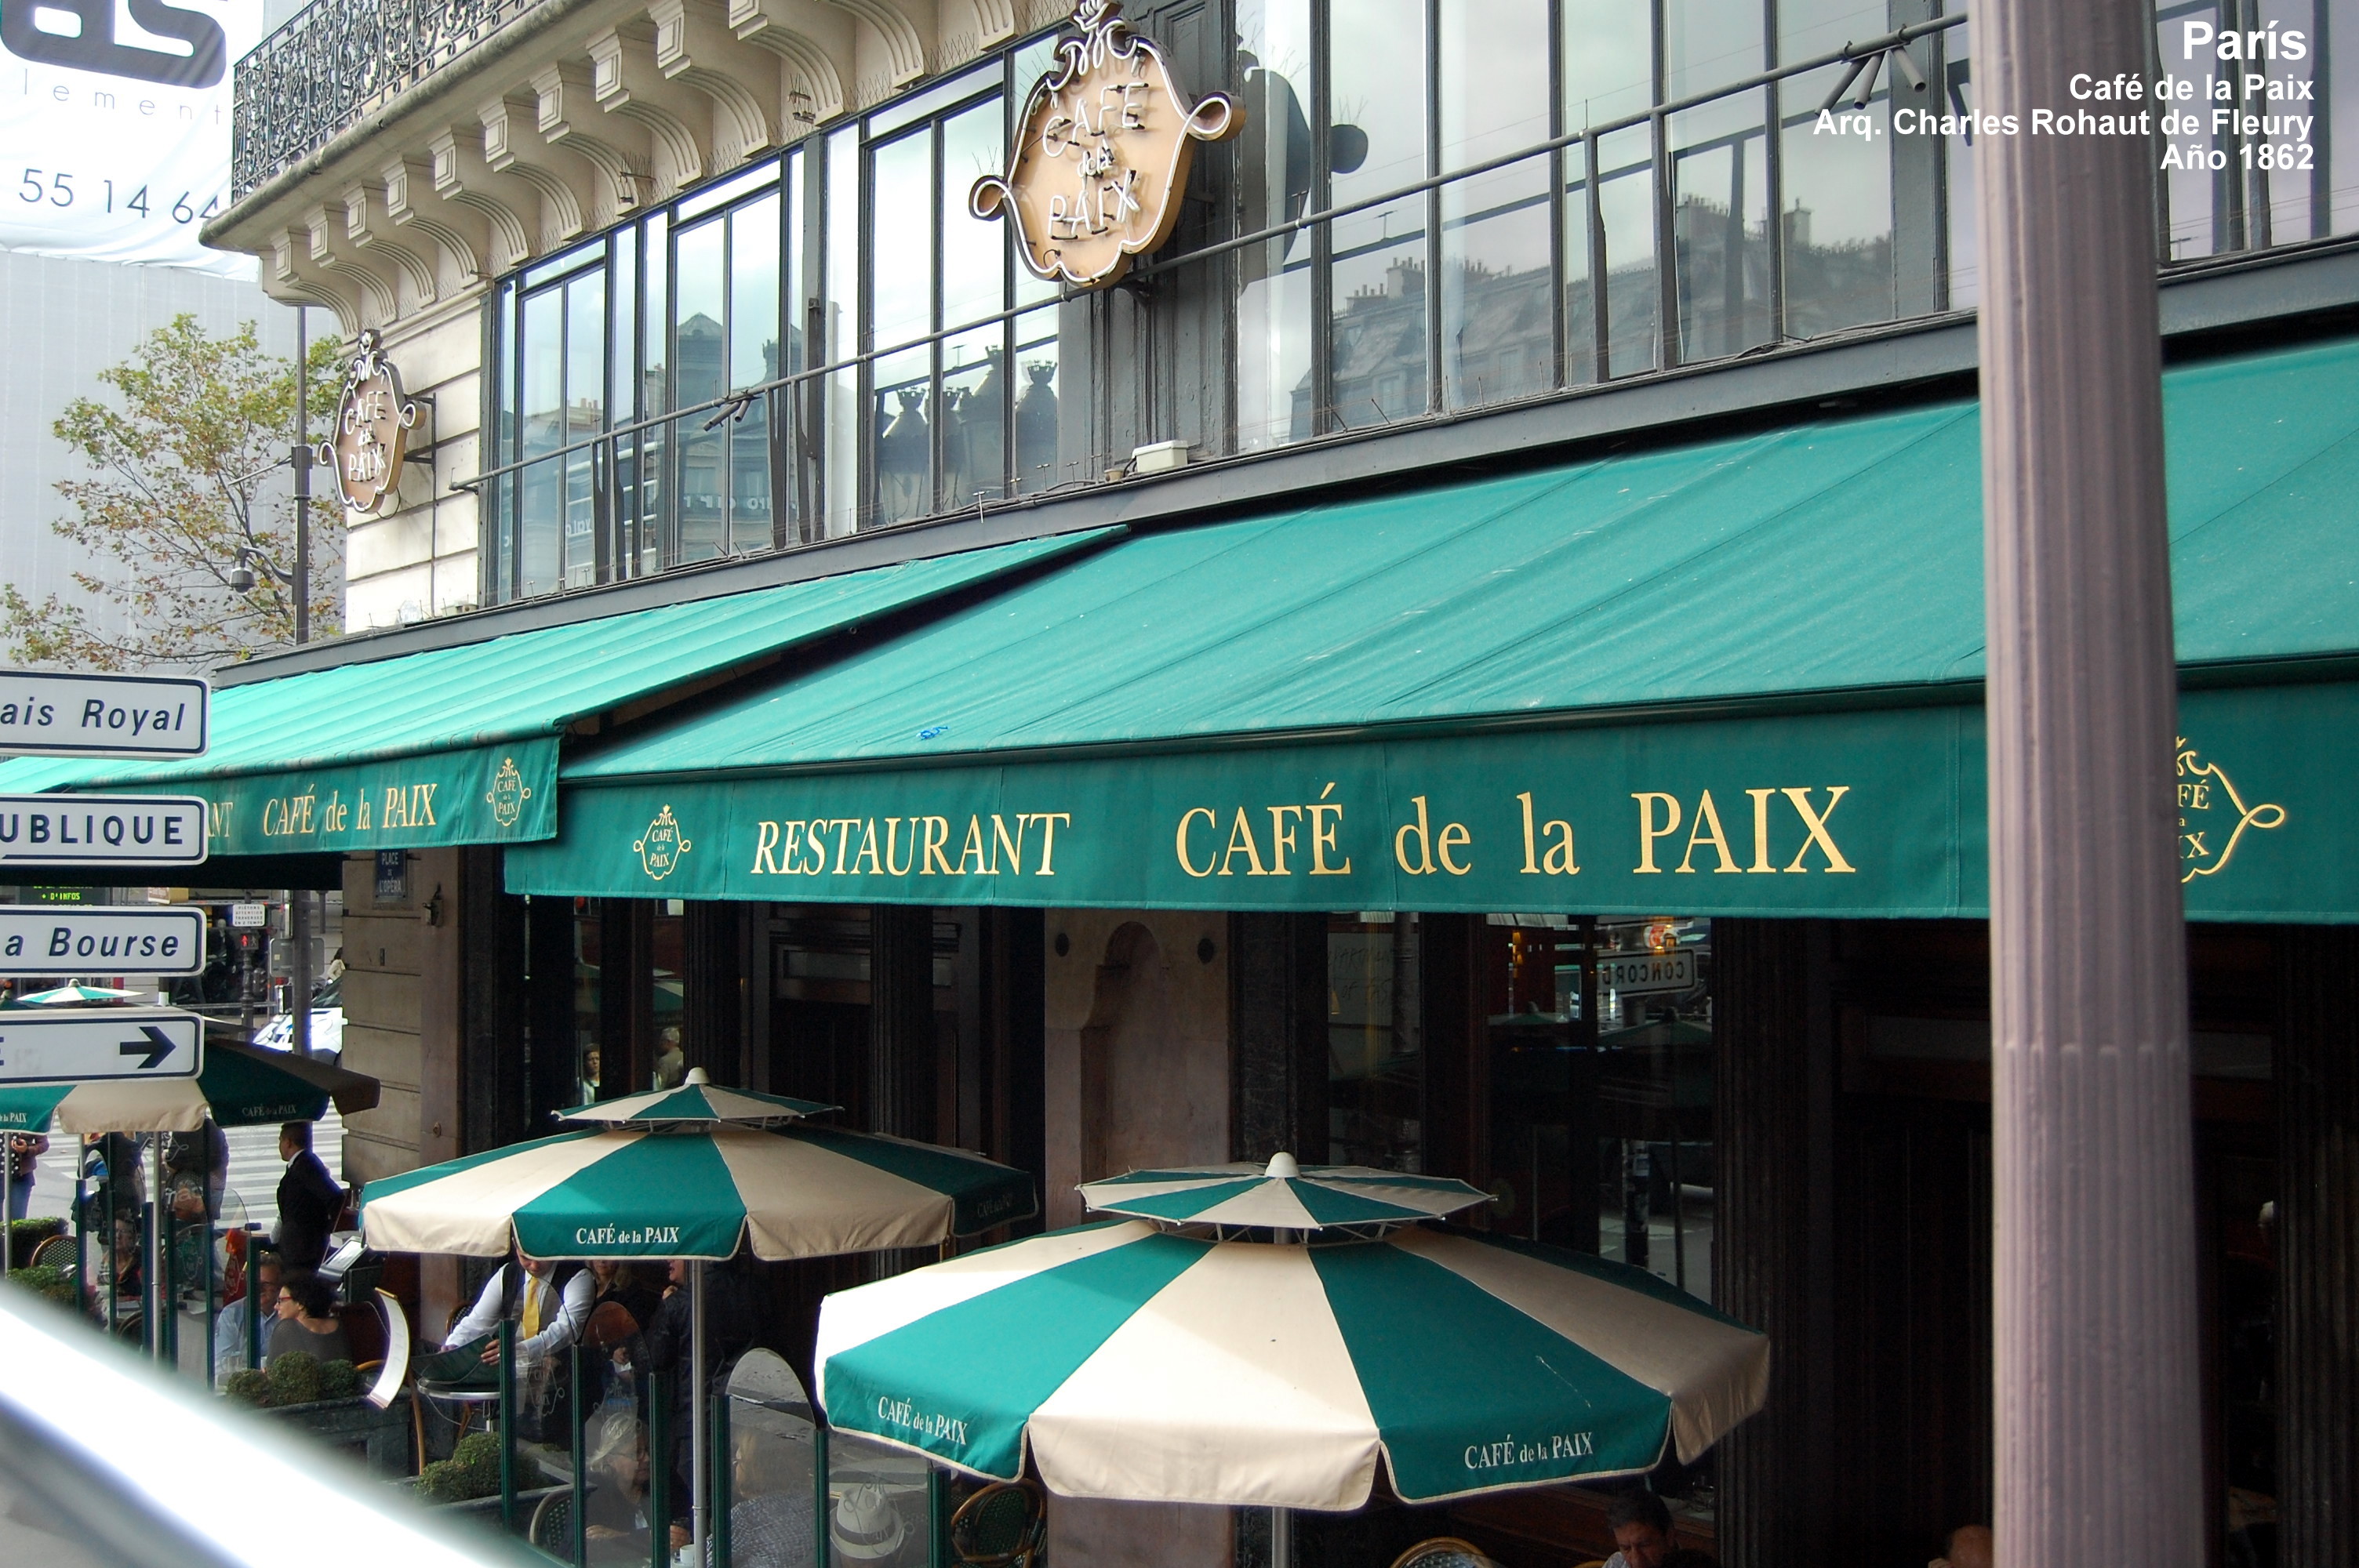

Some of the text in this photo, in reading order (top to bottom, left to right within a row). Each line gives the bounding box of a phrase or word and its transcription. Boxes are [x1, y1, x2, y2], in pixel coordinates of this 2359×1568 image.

[20, 169, 74, 207] 55
[104, 180, 150, 219] 14
[1049, 168, 1140, 240] PAIX
[348, 442, 386, 481] PAIX
[0, 696, 185, 735] ais Royal
[497, 777, 516, 793] CAFÉ
[2176, 779, 2210, 809] FÉ
[263, 784, 315, 837] CAFÉ
[326, 790, 347, 832] de
[356, 788, 371, 830] la
[382, 783, 438, 828] PAIX
[498, 801, 515, 815] PAIX
[0, 814, 183, 846] UBLIQUE
[652, 827, 673, 843] CAFÉ
[751, 782, 1856, 877] RESTAURANT CAFÉ de la PAIX
[649, 852, 669, 867] PAIX
[48, 927, 180, 957] Bourse
[9, 1112, 27, 1123] PAIX
[576, 1222, 680, 1244] CAFÉ de la PAIX
[878, 1396, 969, 1446] CAFÉ de la PAIX
[1464, 1432, 1594, 1469] CAFÉ de la PAIX
